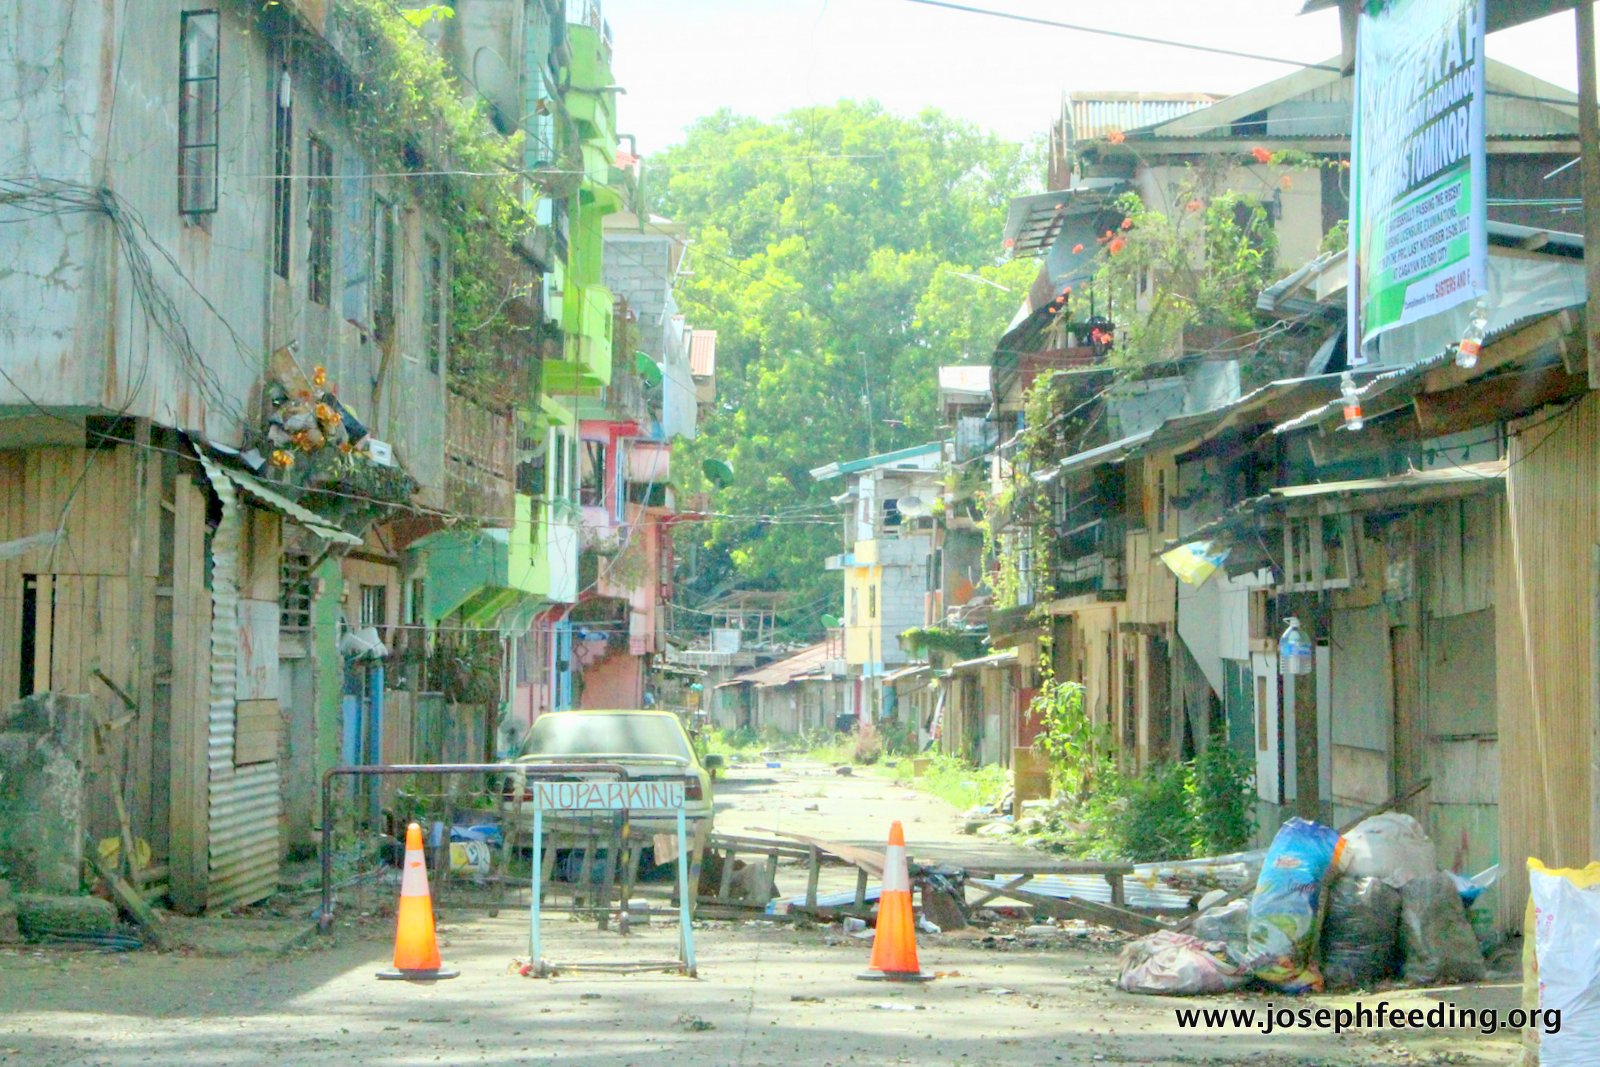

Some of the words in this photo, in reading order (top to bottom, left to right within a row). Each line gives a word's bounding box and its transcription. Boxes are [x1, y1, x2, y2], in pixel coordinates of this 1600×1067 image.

[1434, 192, 1444, 207] THE
[1444, 183, 1461, 203] RECENT
[1420, 228, 1444, 250] NOVEMBER
[1456, 269, 1467, 288] AND
